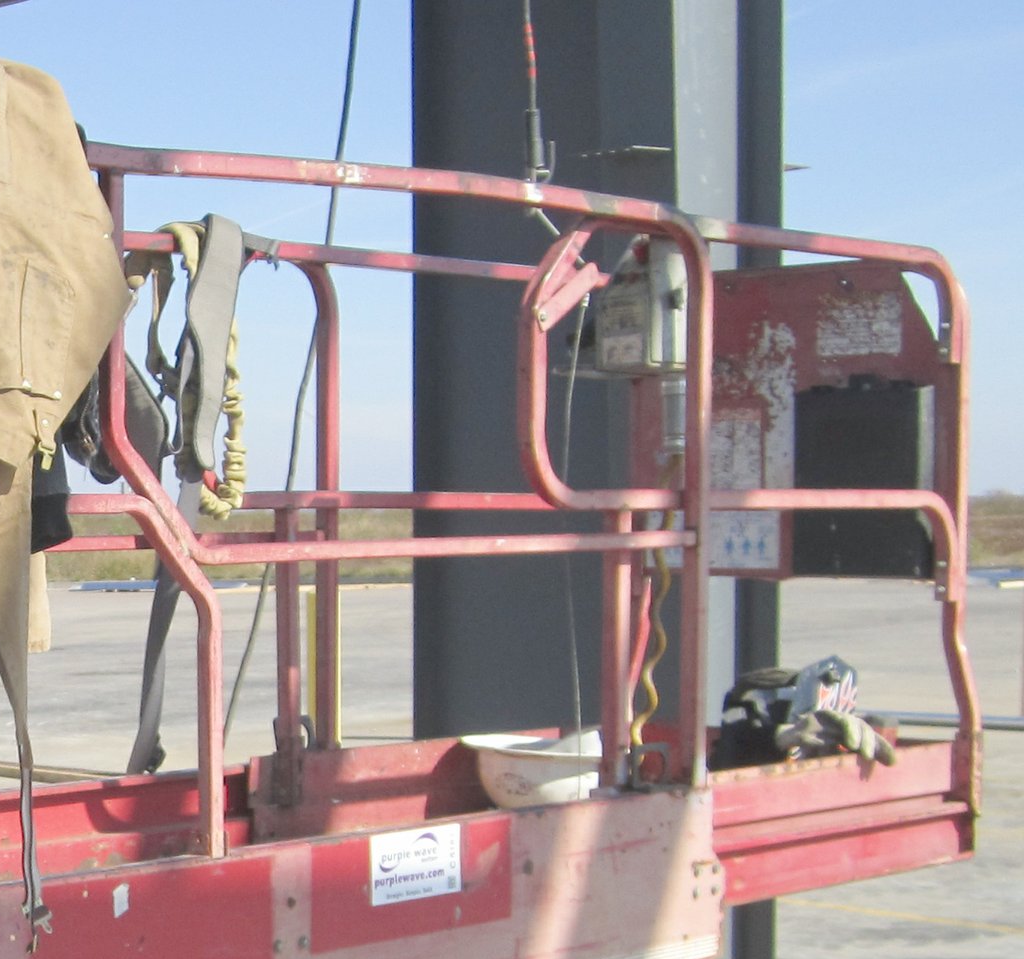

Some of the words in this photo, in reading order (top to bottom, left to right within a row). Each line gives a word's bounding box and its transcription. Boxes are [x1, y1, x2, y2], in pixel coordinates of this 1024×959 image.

[381, 849, 411, 864] purple
[413, 846, 438, 857] wave
[374, 868, 445, 889] purplewave.com
